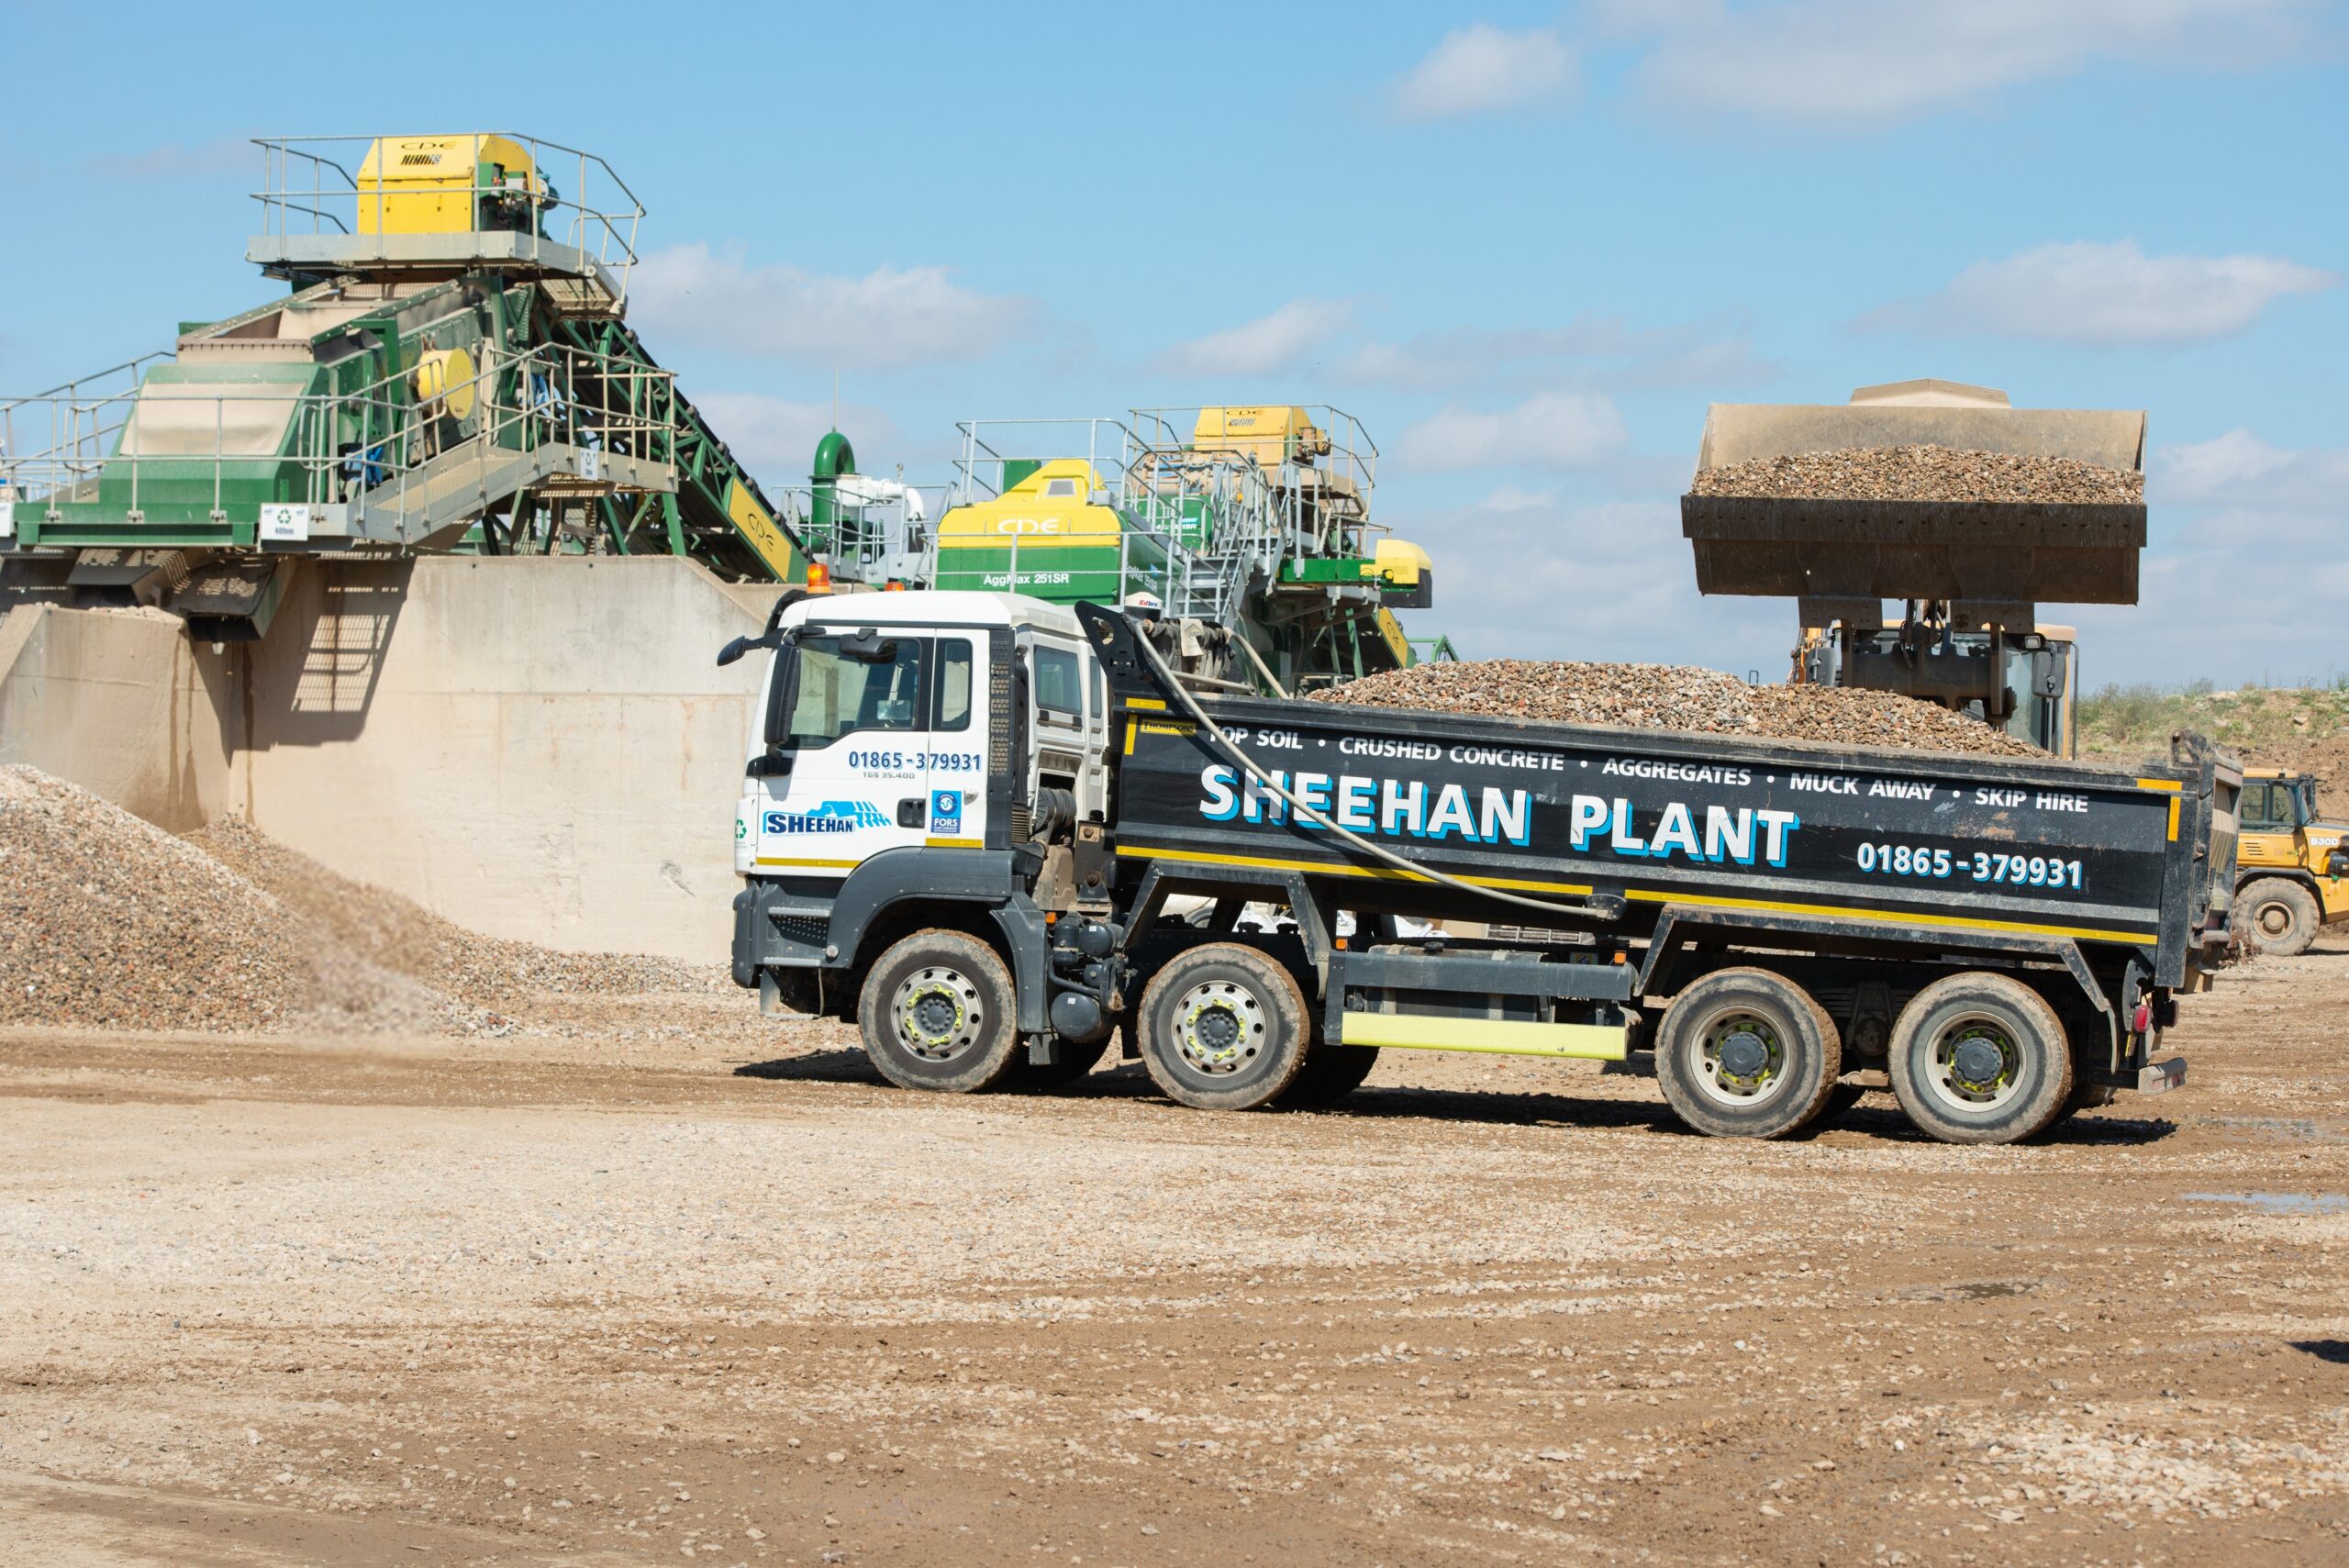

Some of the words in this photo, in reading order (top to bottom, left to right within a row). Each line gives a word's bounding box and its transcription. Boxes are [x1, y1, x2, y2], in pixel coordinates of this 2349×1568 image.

[998, 518, 1058, 535] CDE
[1034, 573, 1069, 584] 251SR
[1143, 721, 1194, 732] THOMPSONS
[1256, 729, 1303, 750] SOIL
[1339, 737, 1442, 762] CRUSHED
[1450, 745, 1564, 772] CONCRETE
[1602, 757, 1752, 786] AGGREGATES
[1789, 773, 1859, 795] MUCK
[1868, 780, 1937, 801] AWAY
[1975, 787, 2027, 808] SKIP
[2035, 793, 2089, 814] HIRE
[767, 814, 854, 834] SHEEHAN
[934, 817, 958, 828] FORS
[1199, 763, 1531, 847] SHEEHAN
[1569, 794, 1800, 868] PLANT
